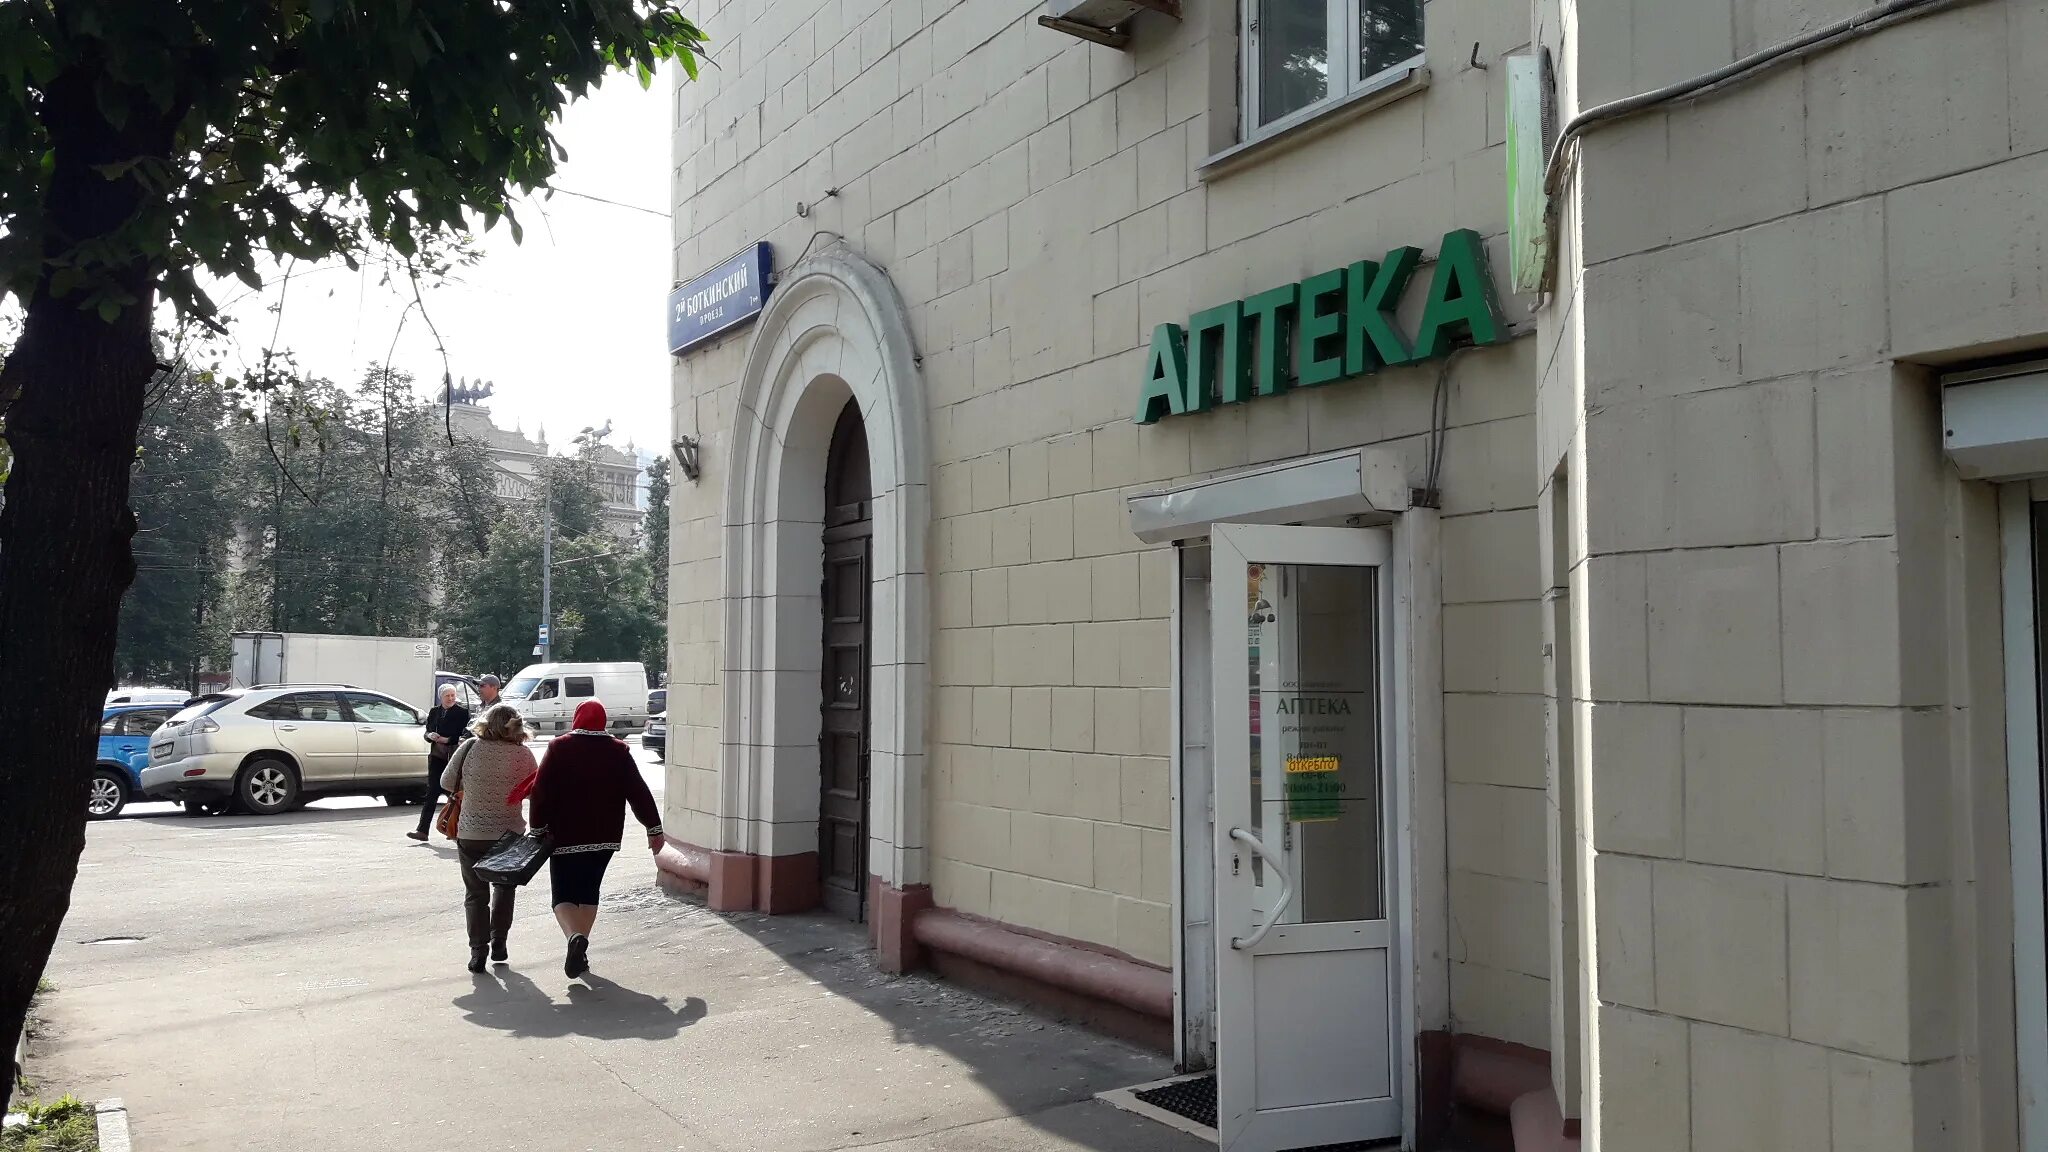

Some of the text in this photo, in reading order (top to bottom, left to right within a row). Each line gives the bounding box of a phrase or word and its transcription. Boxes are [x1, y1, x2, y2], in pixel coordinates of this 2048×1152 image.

[686, 262, 748, 318] БОТКИНСКИЙ
[700, 305, 724, 326] ПРОЕЗД
[1134, 227, 1511, 426] АПТЕКА
[1276, 698, 1351, 715] АПТЕКА
[1289, 760, 1335, 772] ОТКРЫТО
